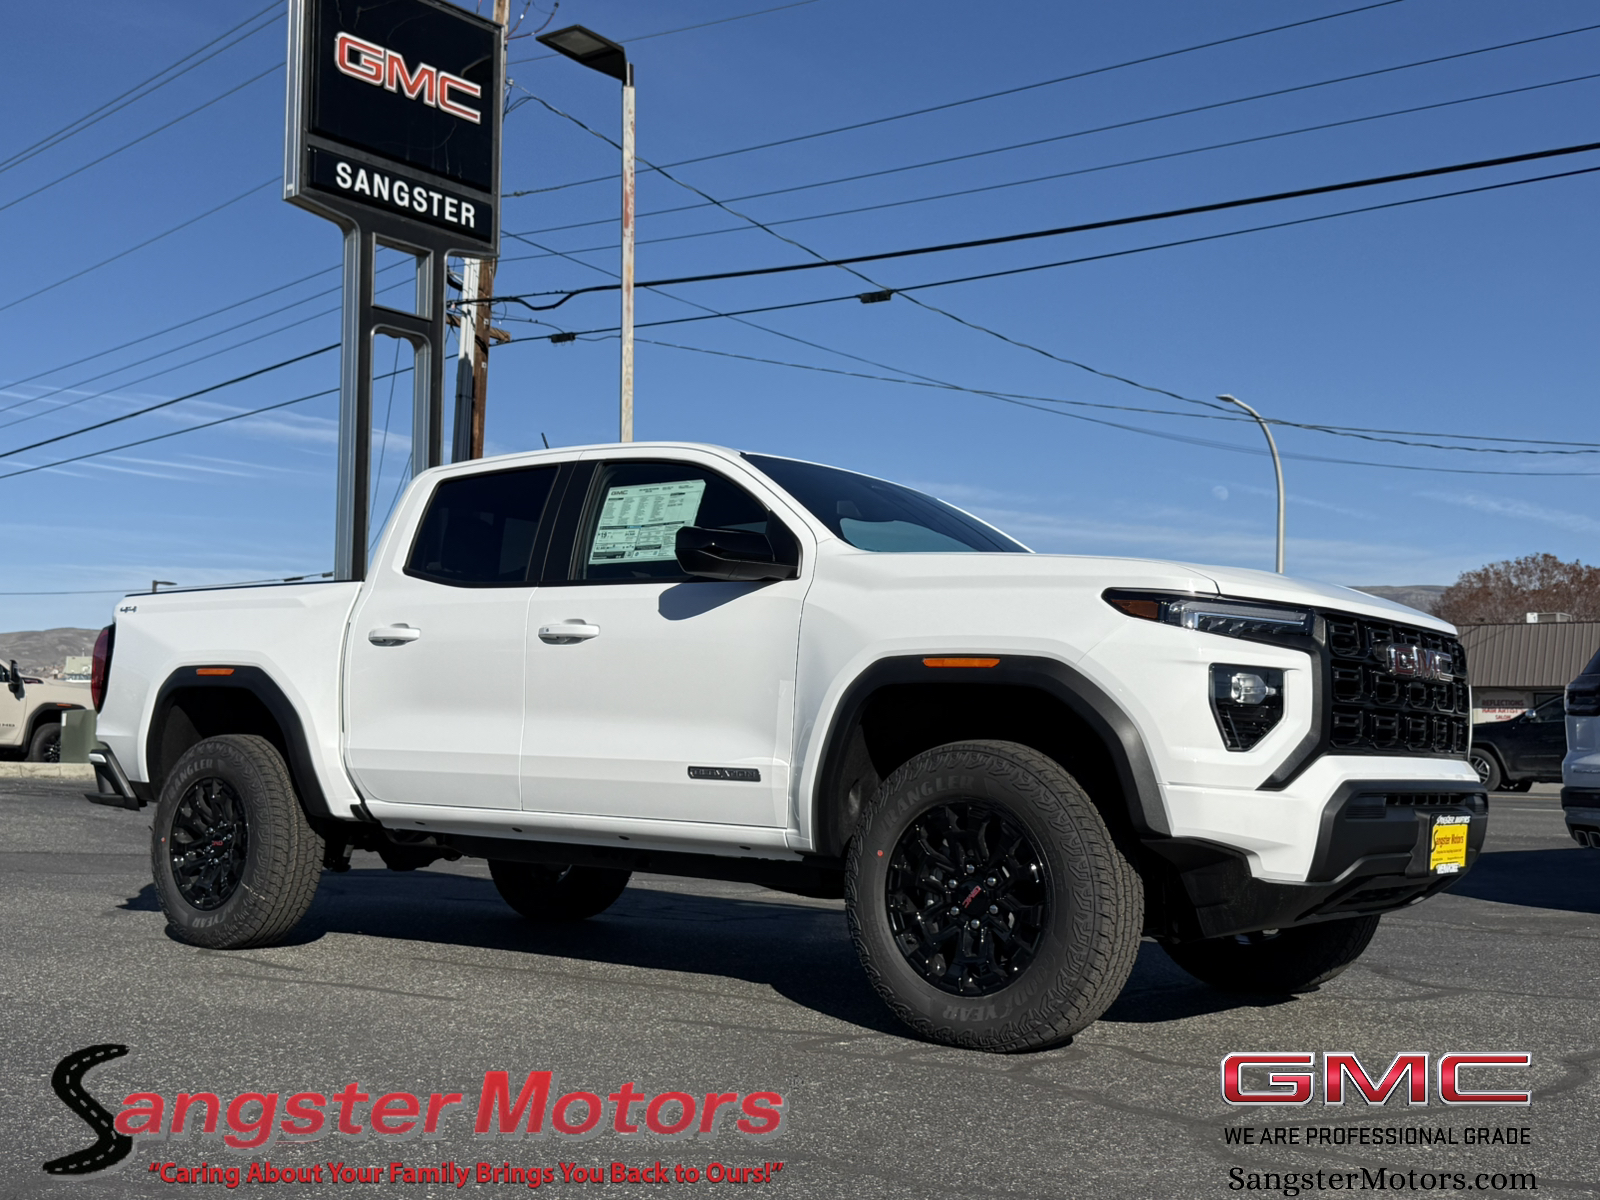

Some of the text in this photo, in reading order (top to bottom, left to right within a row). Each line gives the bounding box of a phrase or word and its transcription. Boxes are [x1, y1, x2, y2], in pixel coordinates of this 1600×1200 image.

[334, 31, 481, 124] GMC
[335, 162, 476, 228] SANGSTER
[1387, 643, 1453, 682] GMC
[871, 774, 976, 844] WRANGLER
[960, 885, 982, 909] GMC
